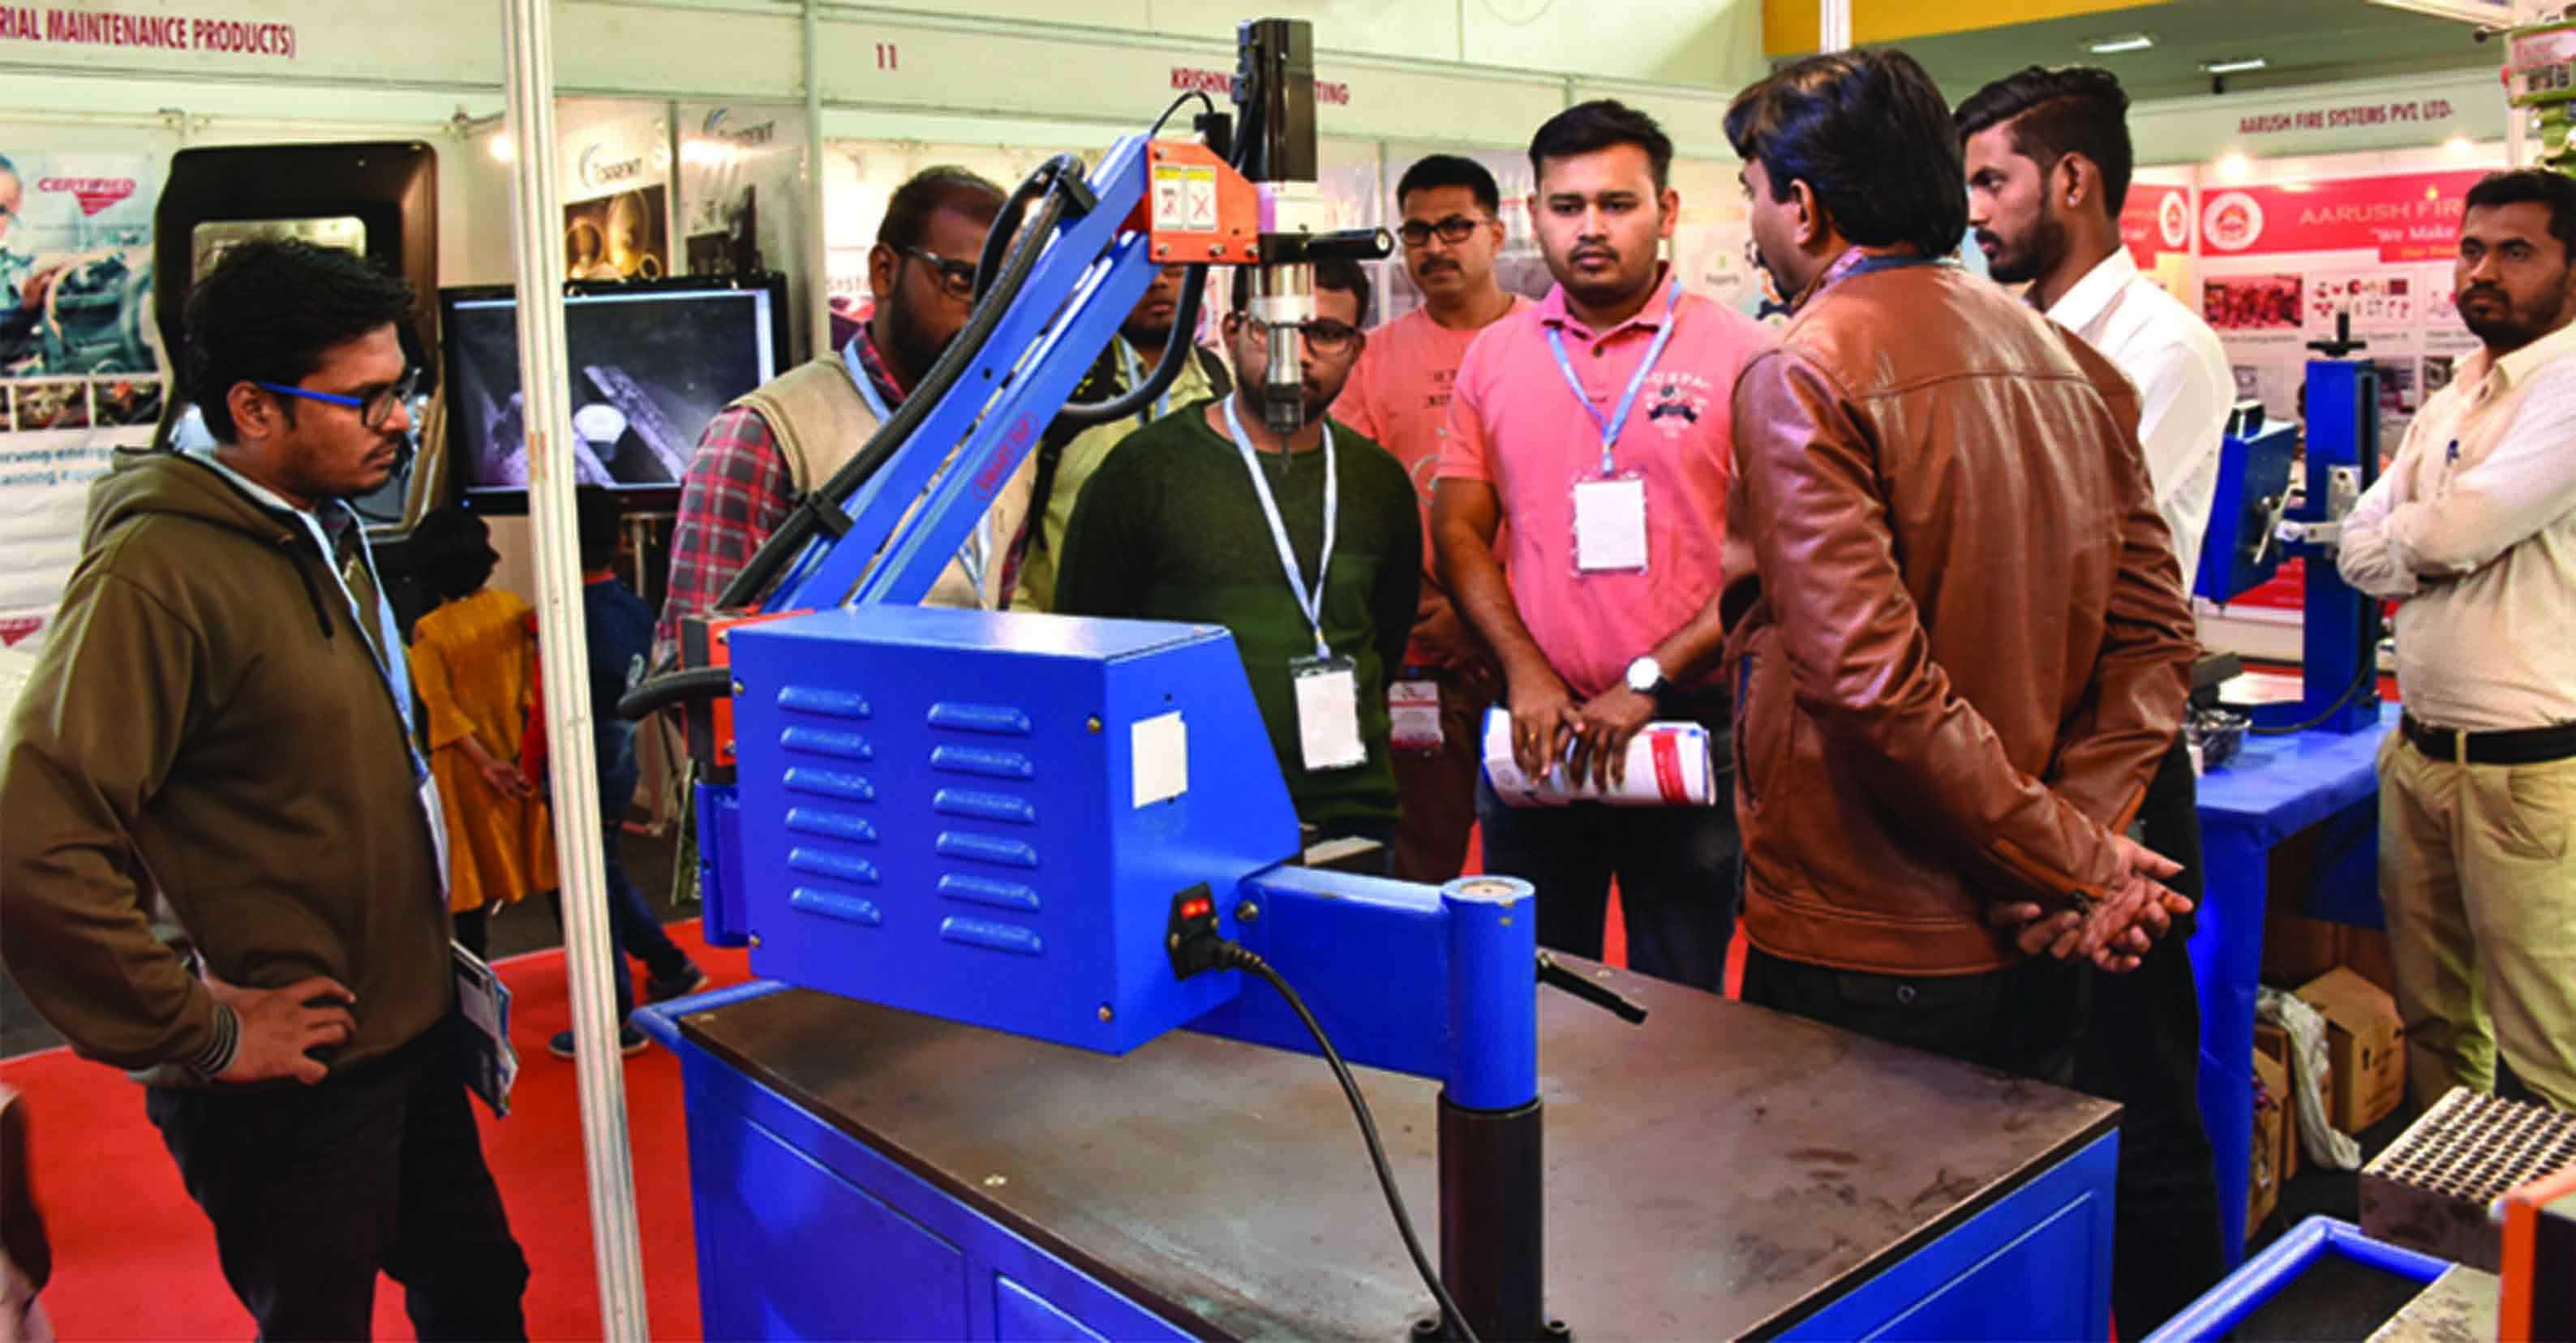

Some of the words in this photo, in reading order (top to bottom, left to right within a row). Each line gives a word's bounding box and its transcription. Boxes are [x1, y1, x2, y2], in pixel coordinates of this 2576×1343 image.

[47, 9, 187, 49] MAINTENANCE
[192, 19, 295, 59] PRODUCTS)
[876, 43, 897, 70] 11
[1171, 68, 1233, 92] KRISHN
[2239, 113, 2291, 134] AARUSH
[2296, 110, 2324, 128] FIRE
[2328, 105, 2386, 127] SYSTEMS
[2299, 201, 2411, 225] AARUSH
[2416, 197, 2463, 219] FIR
